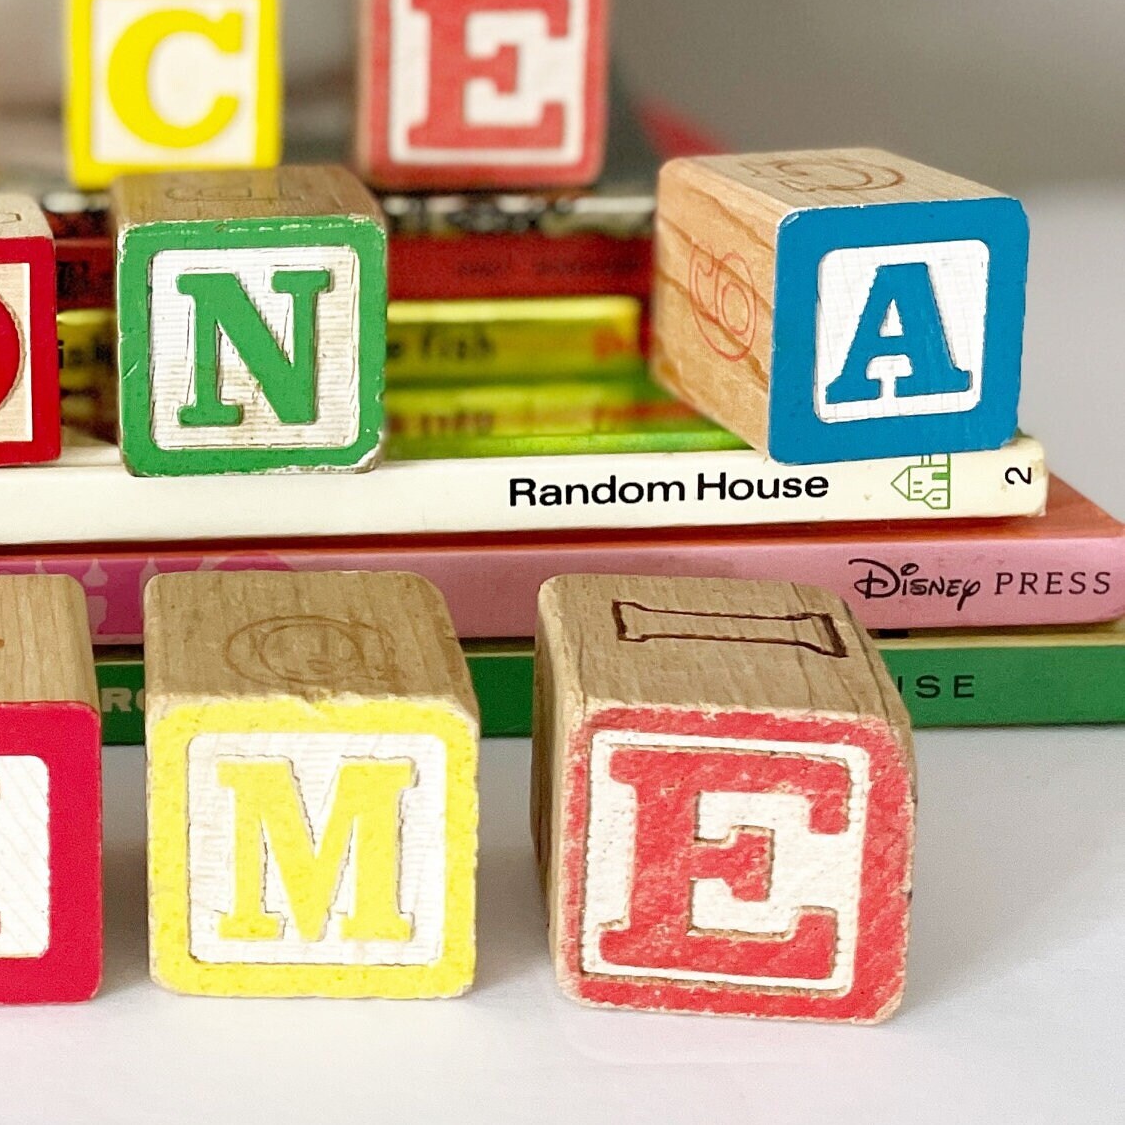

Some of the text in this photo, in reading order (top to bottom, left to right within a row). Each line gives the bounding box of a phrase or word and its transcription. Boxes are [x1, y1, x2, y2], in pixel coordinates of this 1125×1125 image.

[825, 261, 973, 405] A
[509, 471, 830, 507] Random House
[1004, 466, 1033, 486] 2
[993, 571, 1112, 596] PRESS
